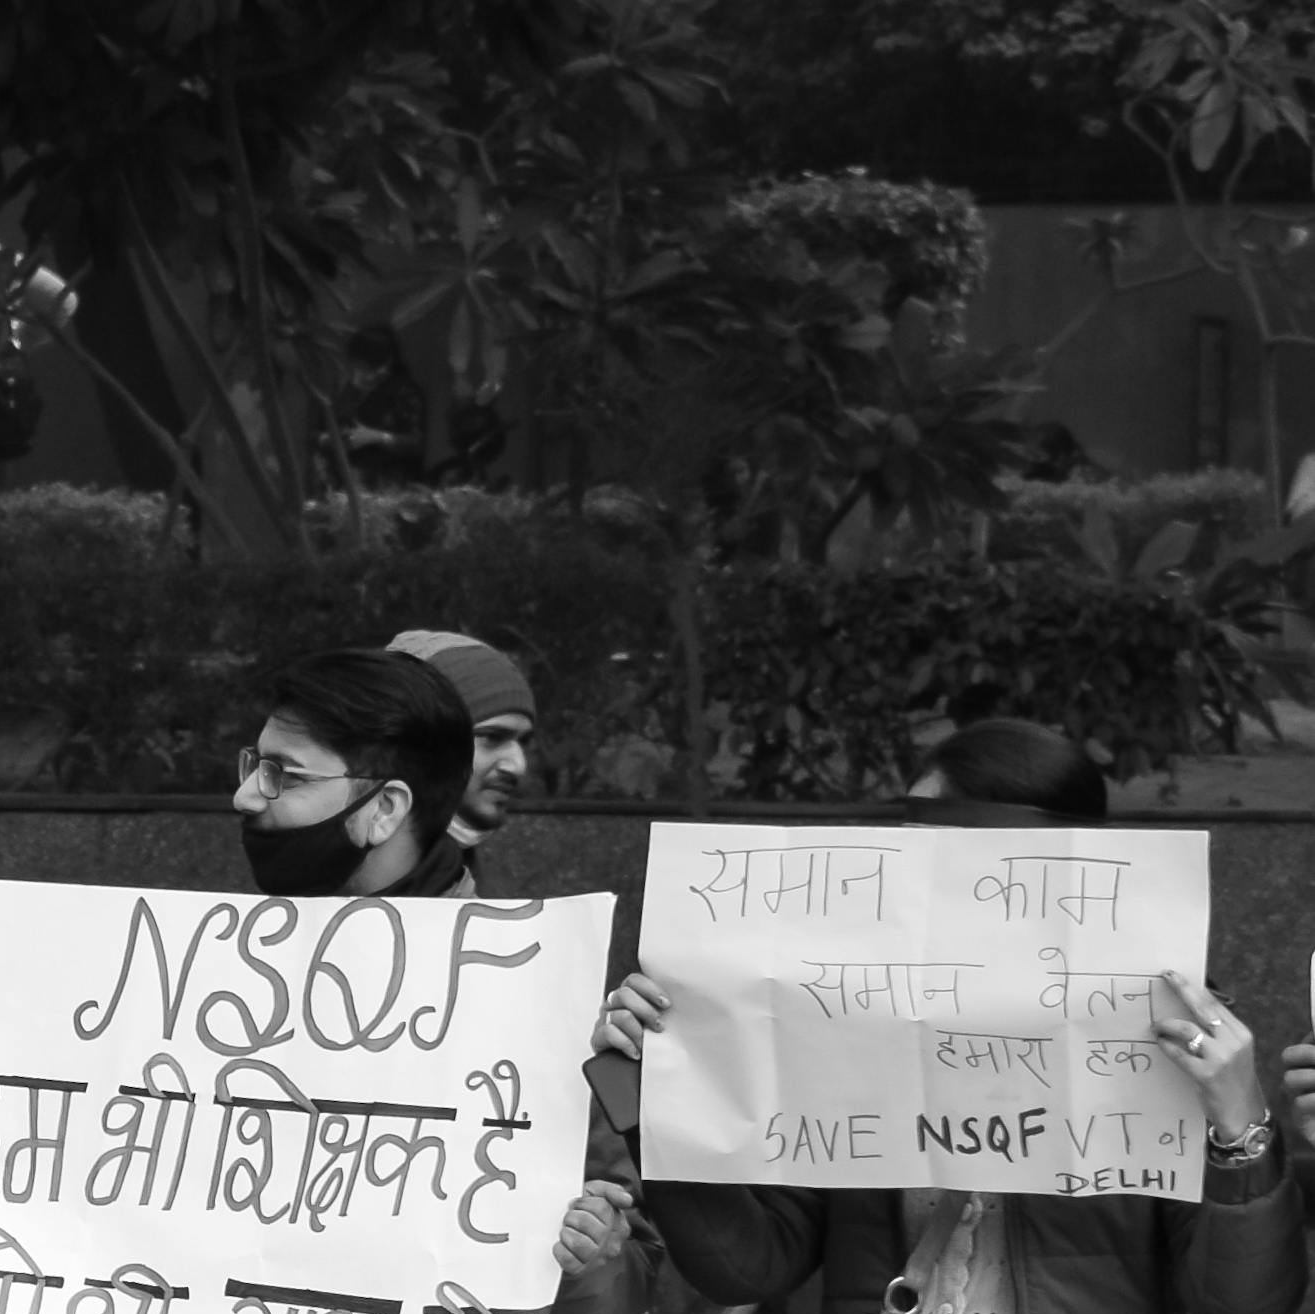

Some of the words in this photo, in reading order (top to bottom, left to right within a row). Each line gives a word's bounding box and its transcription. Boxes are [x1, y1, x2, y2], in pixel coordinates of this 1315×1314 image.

[689, 845, 902, 922] समान
[974, 856, 1131, 931] काम
[73, 896, 544, 1057] NSQF
[799, 960, 984, 1018] समान
[1038, 946, 1166, 1028] वेतन
[936, 1029, 1053, 1088] हमारा
[1086, 1038, 1160, 1076] हक
[85, 1052, 196, 1211] भी
[206, 1057, 458, 1232] शिक्षक
[458, 1059, 531, 1243] हैं
[764, 1111, 882, 1166] SAVE
[916, 1106, 1047, 1165] NSQF
[1055, 1168, 1178, 1195] DELHI
